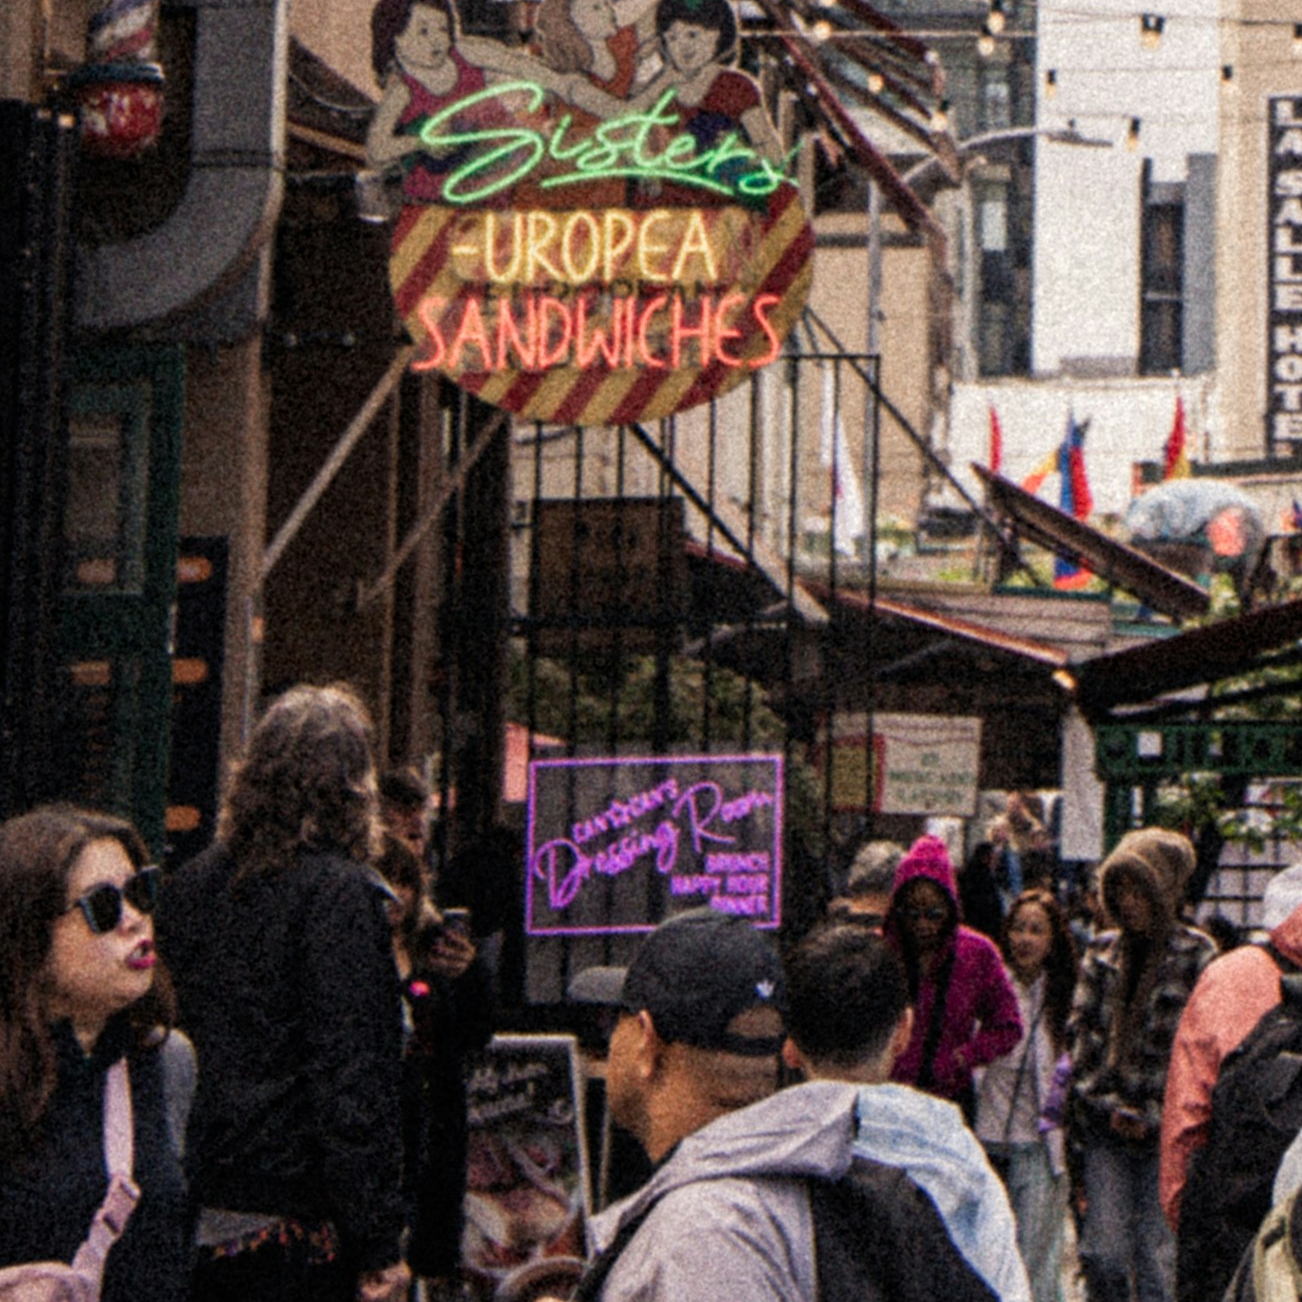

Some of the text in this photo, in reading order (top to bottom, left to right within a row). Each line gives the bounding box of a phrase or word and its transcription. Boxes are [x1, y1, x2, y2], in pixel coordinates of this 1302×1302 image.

[420, 80, 802, 203] Sisters
[411, 293, 783, 372] SANDWICHES
[534, 821, 682, 910] Dressing
